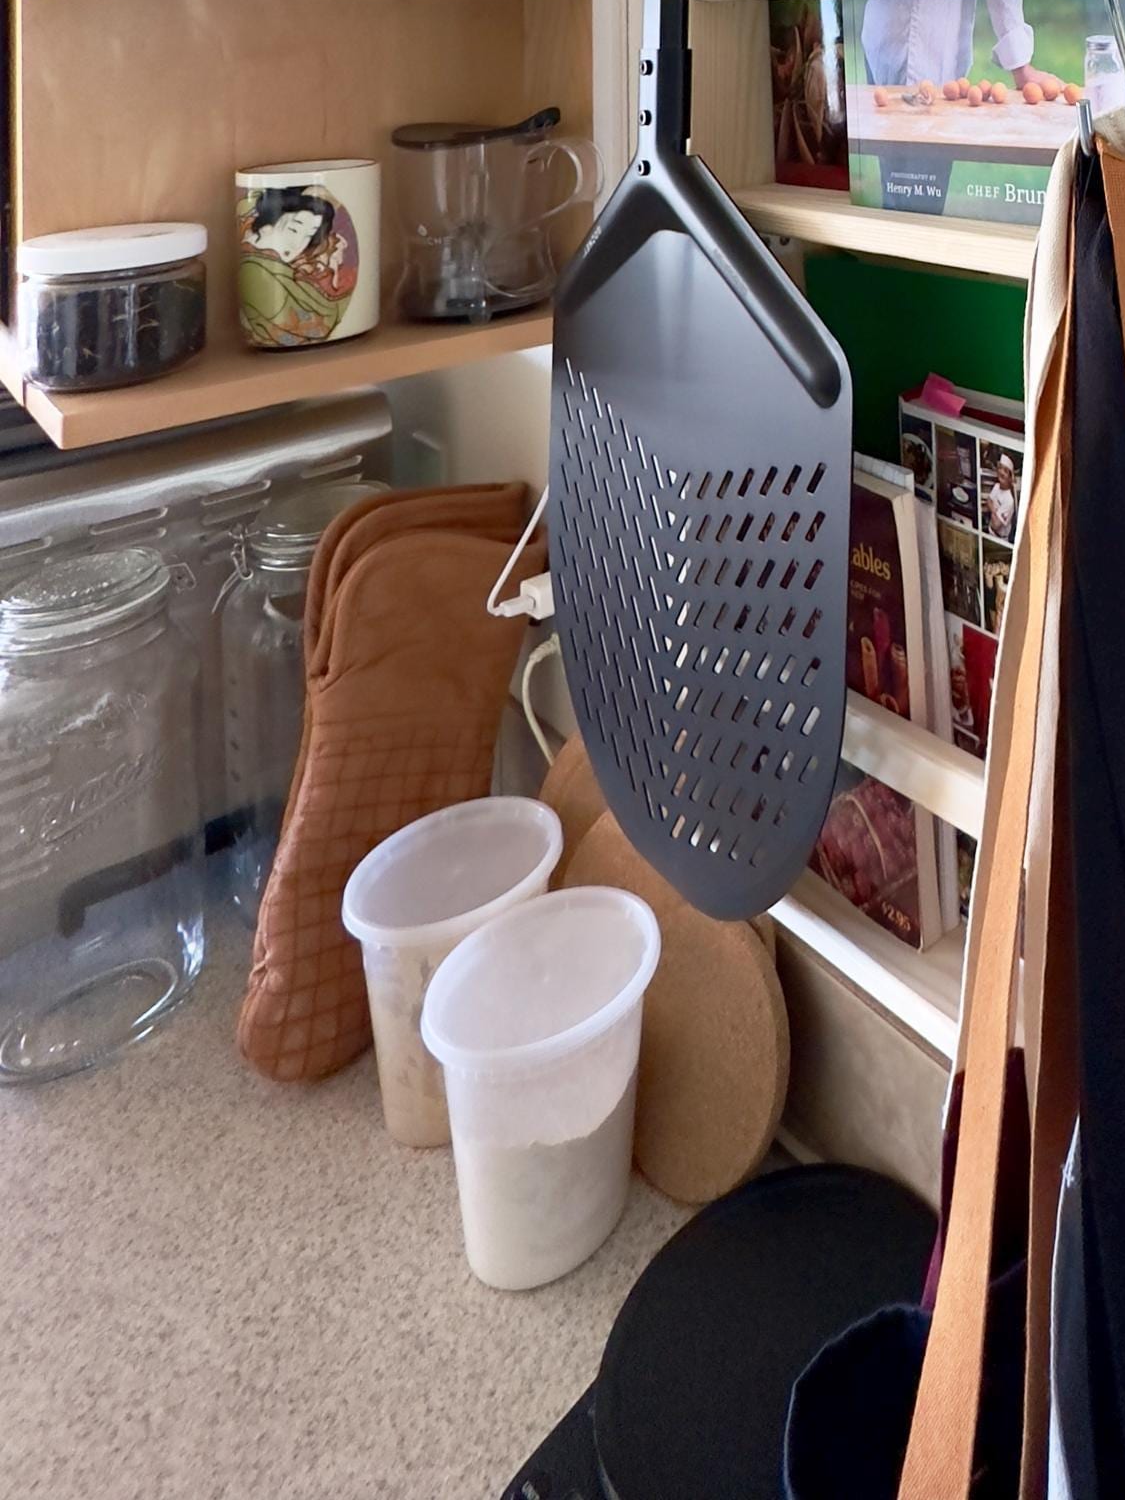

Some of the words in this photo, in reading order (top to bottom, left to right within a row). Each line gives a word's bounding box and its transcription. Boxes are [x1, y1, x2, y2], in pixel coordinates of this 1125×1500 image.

[886, 182, 912, 199] Henry
[926, 185, 942, 198] Wu
[966, 183, 1001, 199] CHEF
